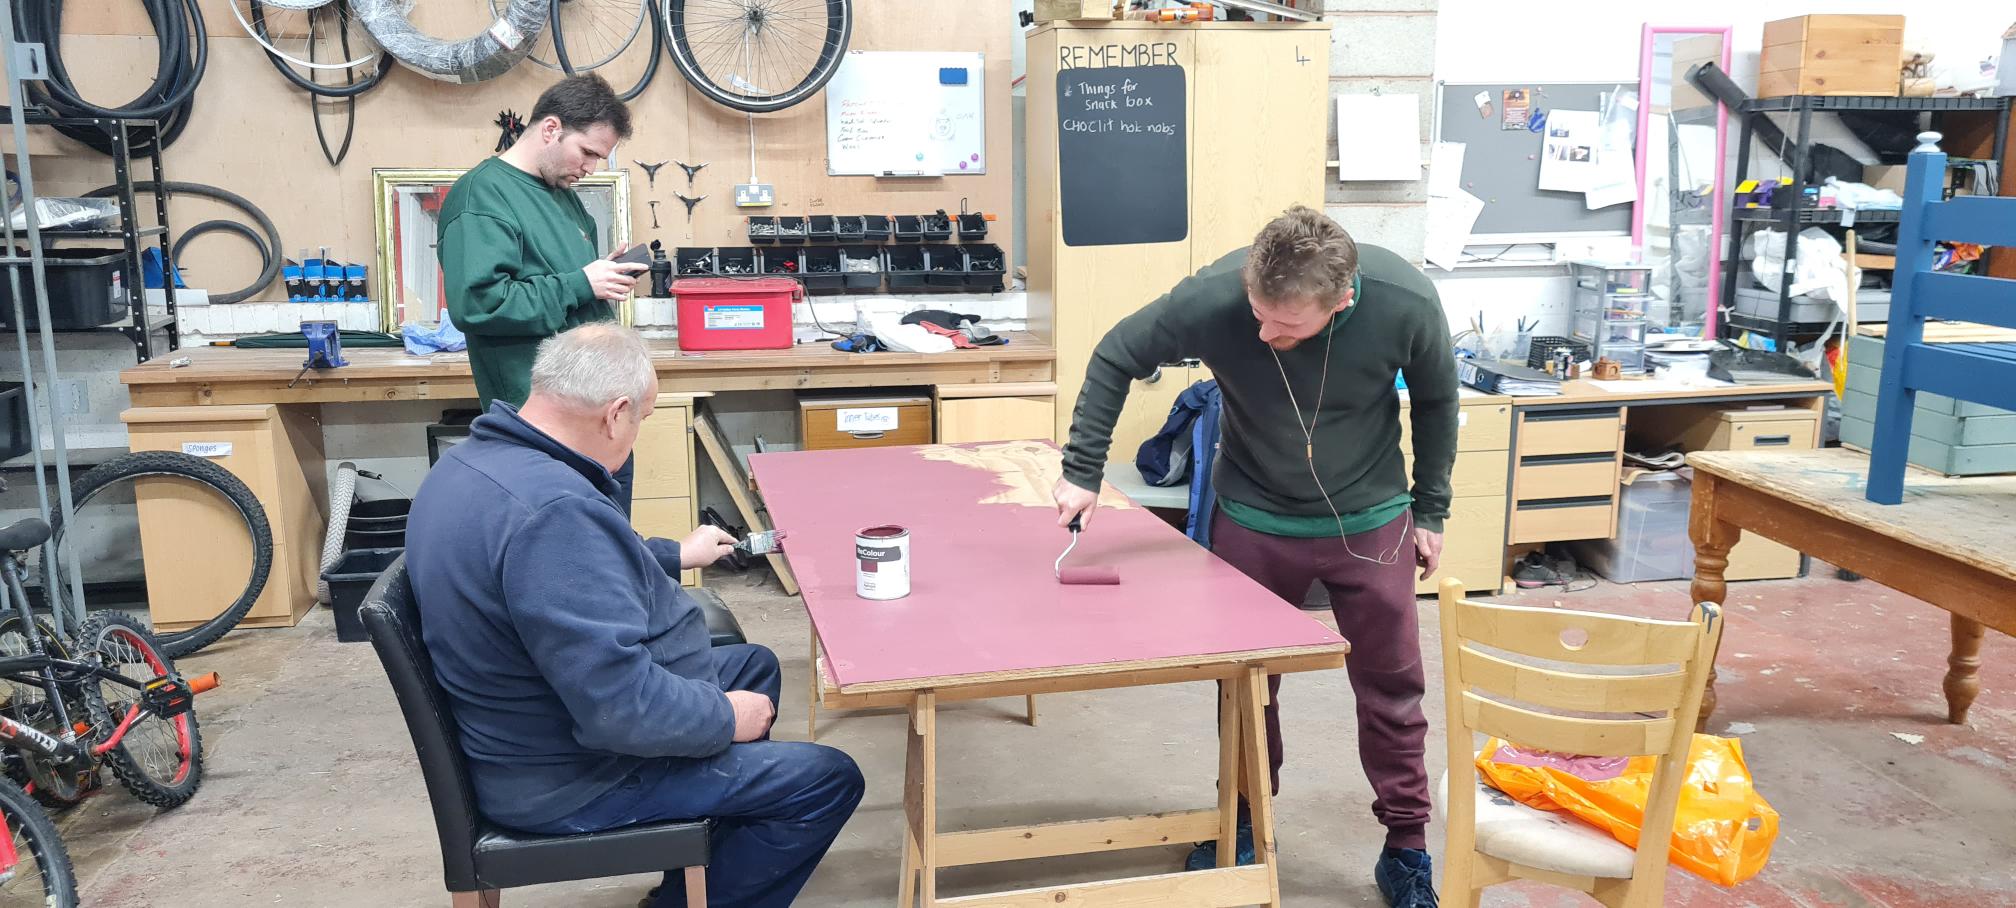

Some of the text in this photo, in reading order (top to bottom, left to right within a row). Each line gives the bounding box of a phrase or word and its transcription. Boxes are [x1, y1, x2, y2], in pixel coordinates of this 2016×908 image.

[1060, 42, 1179, 69] REMEMBER
[1078, 78, 1138, 99] Things for
[1126, 96, 1153, 108] box
